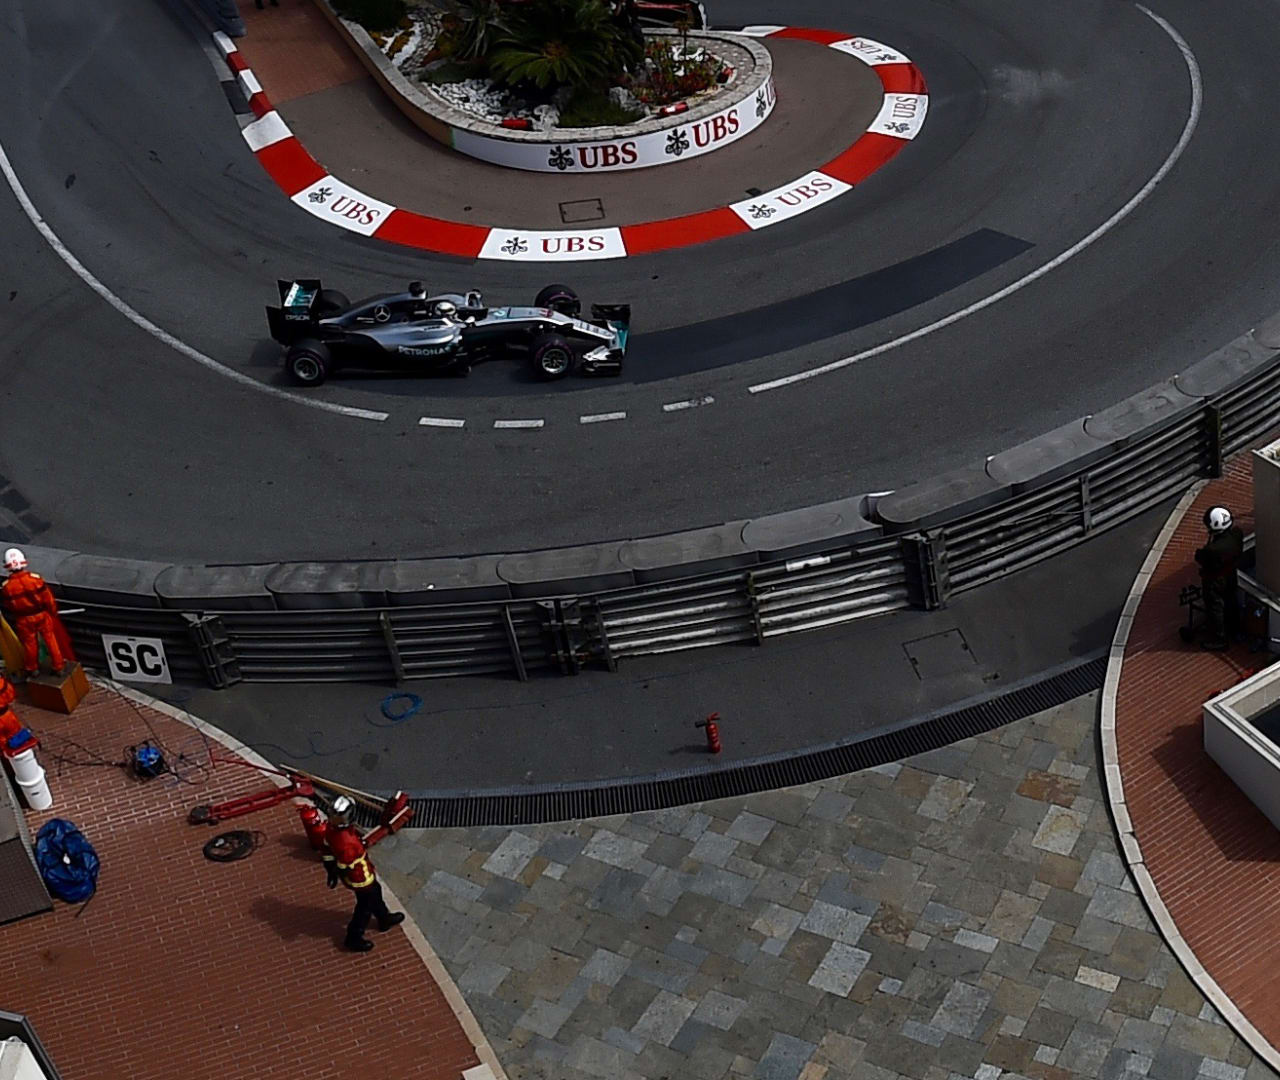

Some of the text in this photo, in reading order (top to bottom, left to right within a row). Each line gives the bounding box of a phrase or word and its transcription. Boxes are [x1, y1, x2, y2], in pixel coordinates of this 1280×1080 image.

[892, 96, 918, 119] UBS
[692, 109, 739, 149] UBS
[578, 141, 638, 169] UBS
[776, 177, 833, 208] UBS
[330, 196, 381, 226] UBS
[541, 236, 605, 254] UBS
[111, 642, 162, 676] SC
